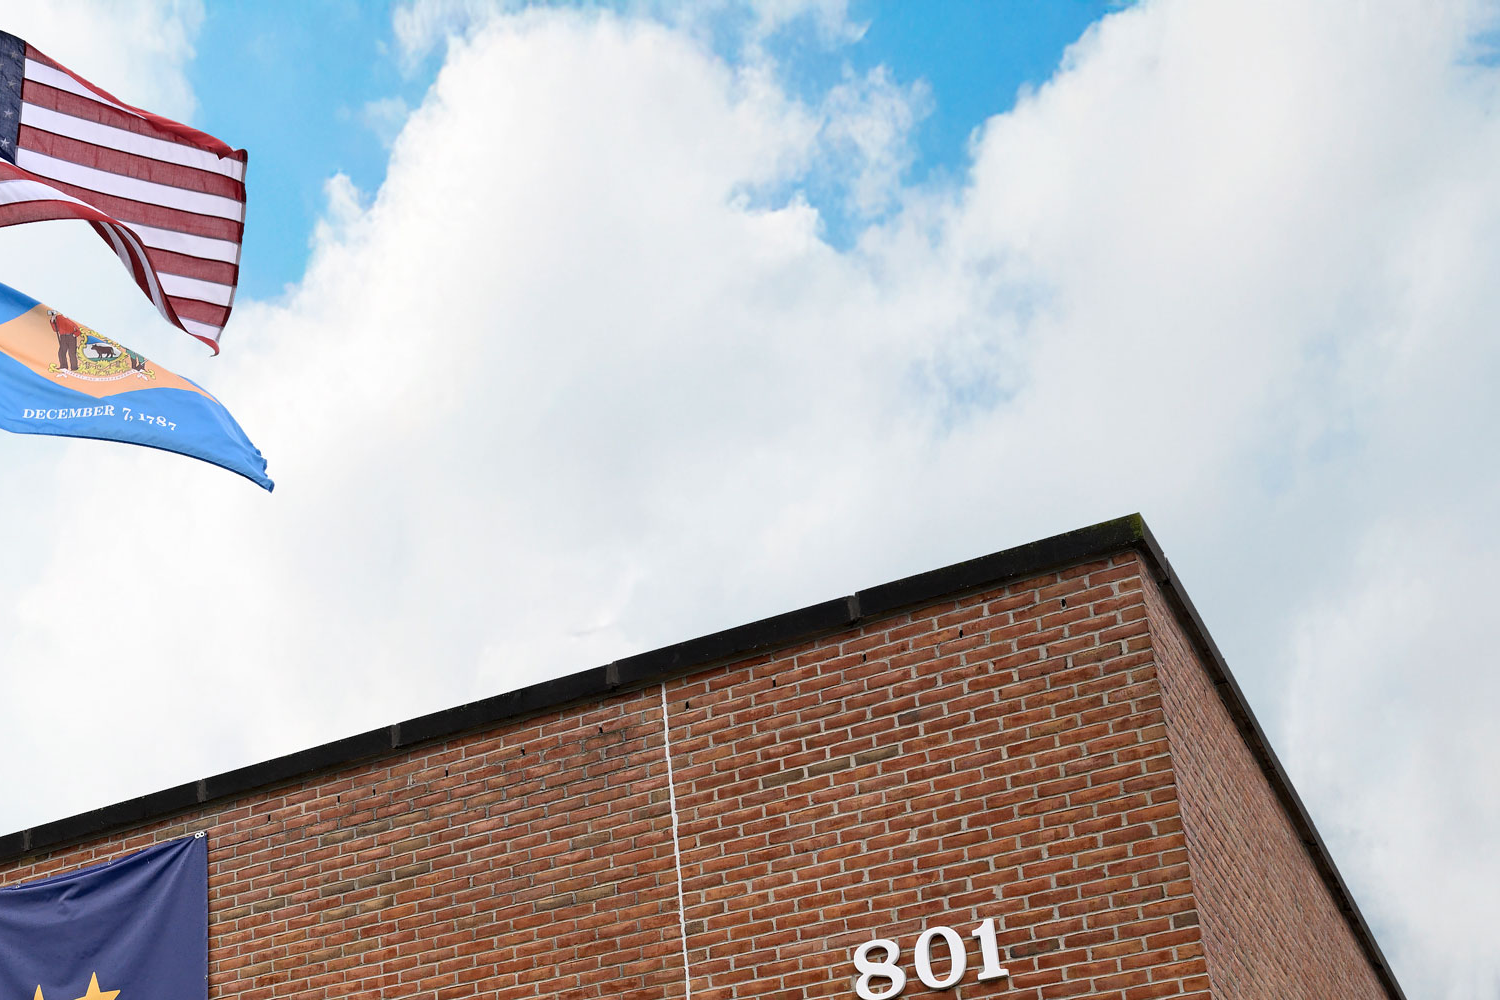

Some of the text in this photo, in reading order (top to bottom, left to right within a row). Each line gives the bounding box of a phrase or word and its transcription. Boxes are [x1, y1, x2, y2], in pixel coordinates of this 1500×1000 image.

[22, 405, 177, 431] DECEMBER 7, 1787
